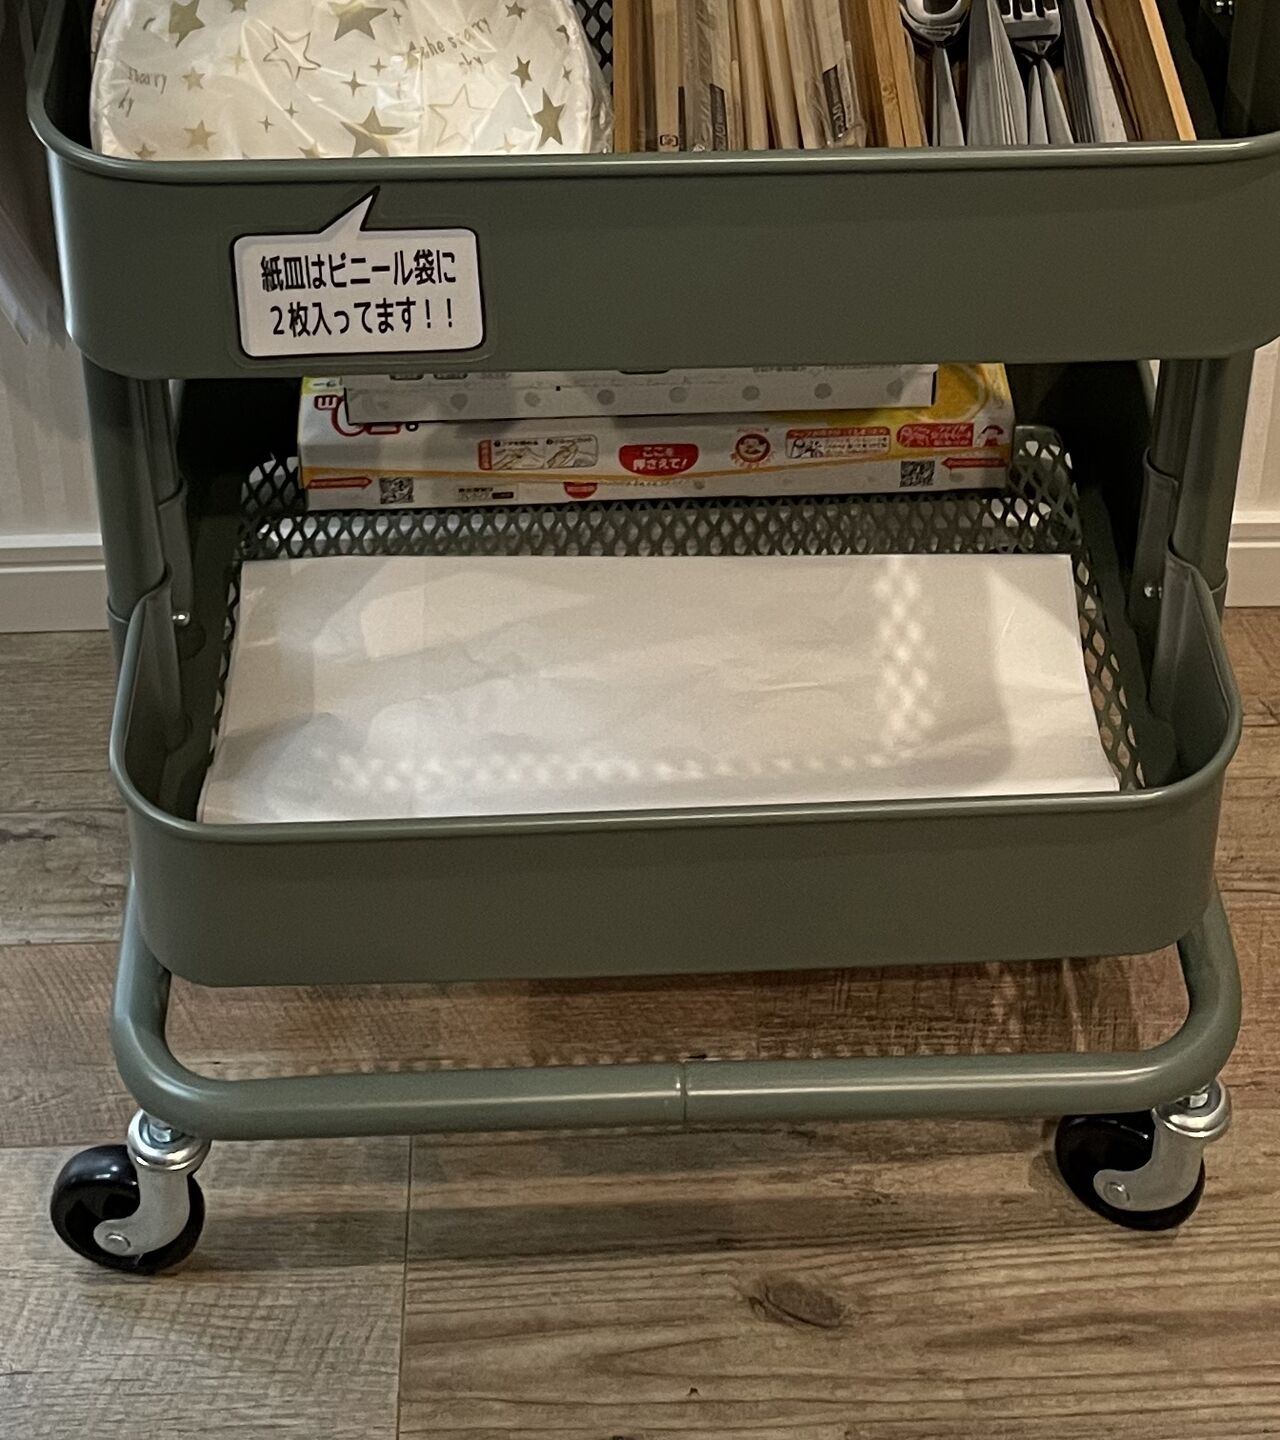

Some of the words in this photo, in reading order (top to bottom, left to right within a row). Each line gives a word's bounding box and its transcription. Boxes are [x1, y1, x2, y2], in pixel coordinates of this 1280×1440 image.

[261, 249, 457, 293] 紙皿はビニール袋に
